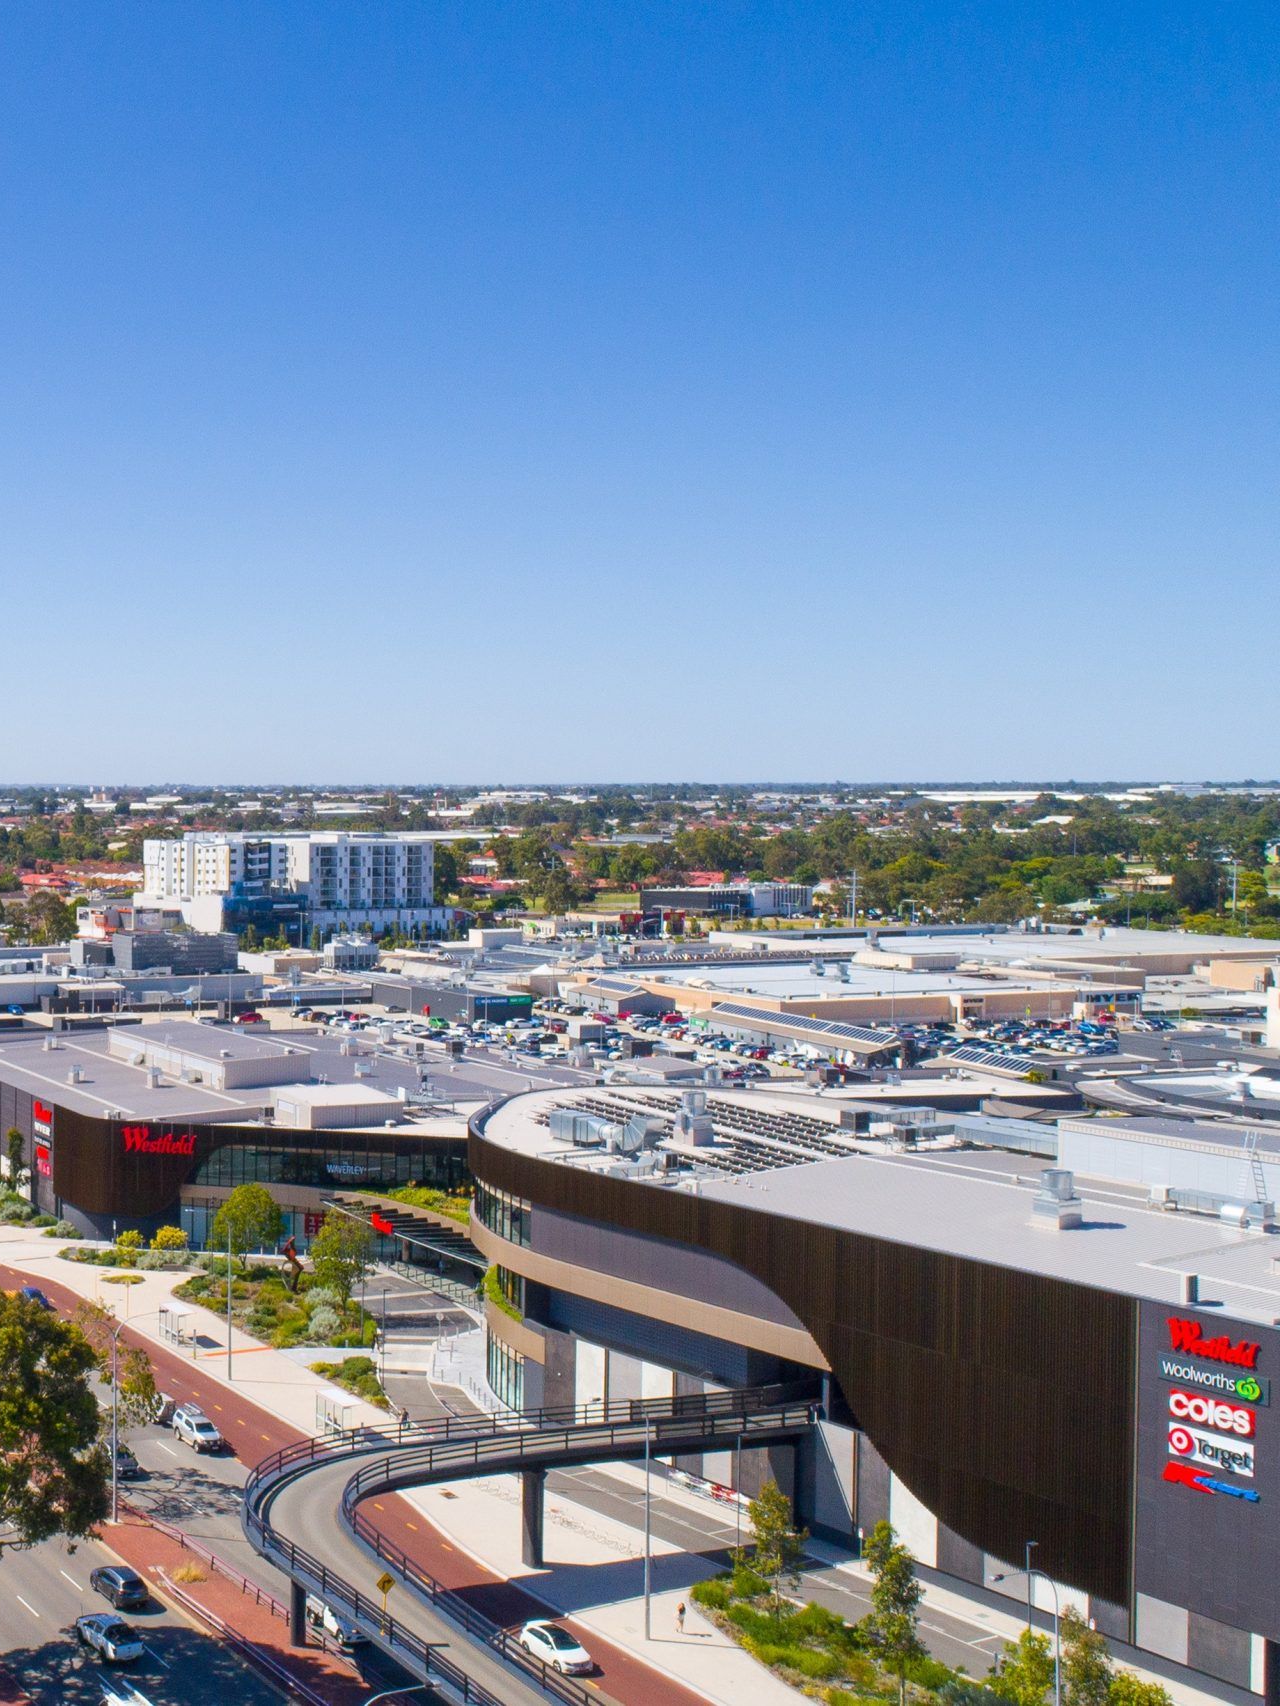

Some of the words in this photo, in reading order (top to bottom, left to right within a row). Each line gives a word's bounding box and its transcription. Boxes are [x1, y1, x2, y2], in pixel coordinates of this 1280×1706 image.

[1086, 992, 1140, 1003] MYER
[122, 1126, 197, 1155] Westfield
[326, 1163, 365, 1175] WAVERLEY
[1167, 1317, 1260, 1368] Westfield
[1162, 1360, 1236, 1392] Woolworths
[1169, 1393, 1252, 1435] coles
[1195, 1437, 1253, 1469] Target
